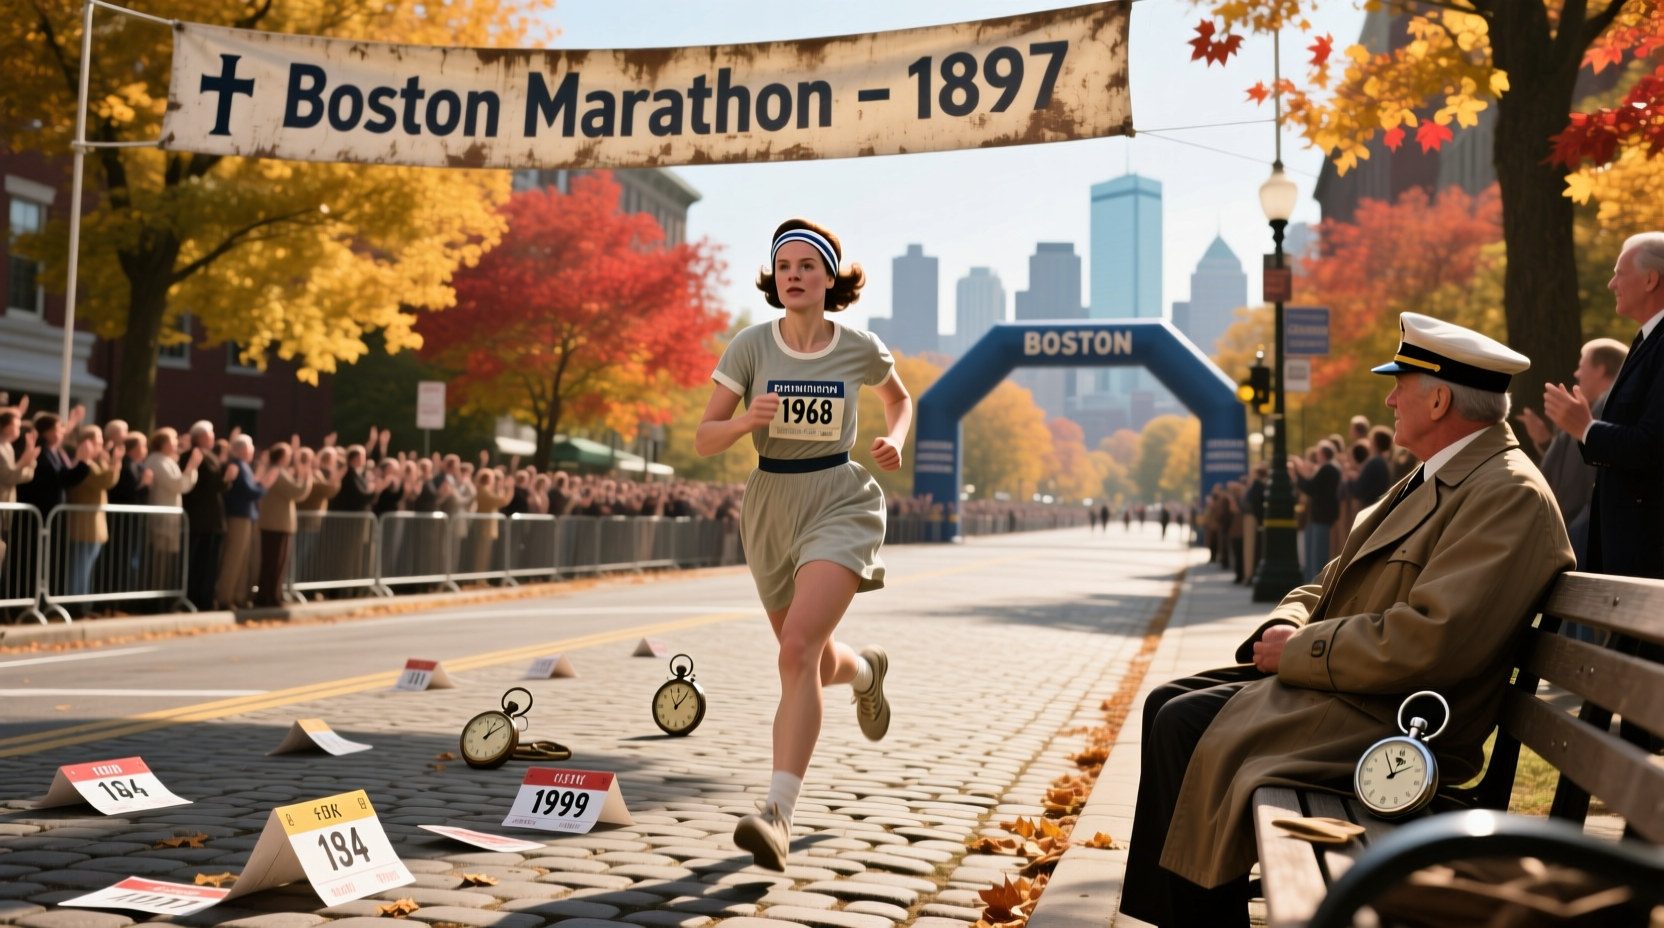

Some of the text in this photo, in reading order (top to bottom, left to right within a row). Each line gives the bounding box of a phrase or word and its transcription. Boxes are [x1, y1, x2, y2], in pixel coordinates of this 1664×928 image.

[283, 62, 501, 138] Boston
[523, 67, 833, 138] Marathon
[907, 39, 1069, 120] 1897
[1024, 331, 1132, 355] BOSTON
[782, 398, 833, 425] 1968
[531, 789, 590, 818] 1999
